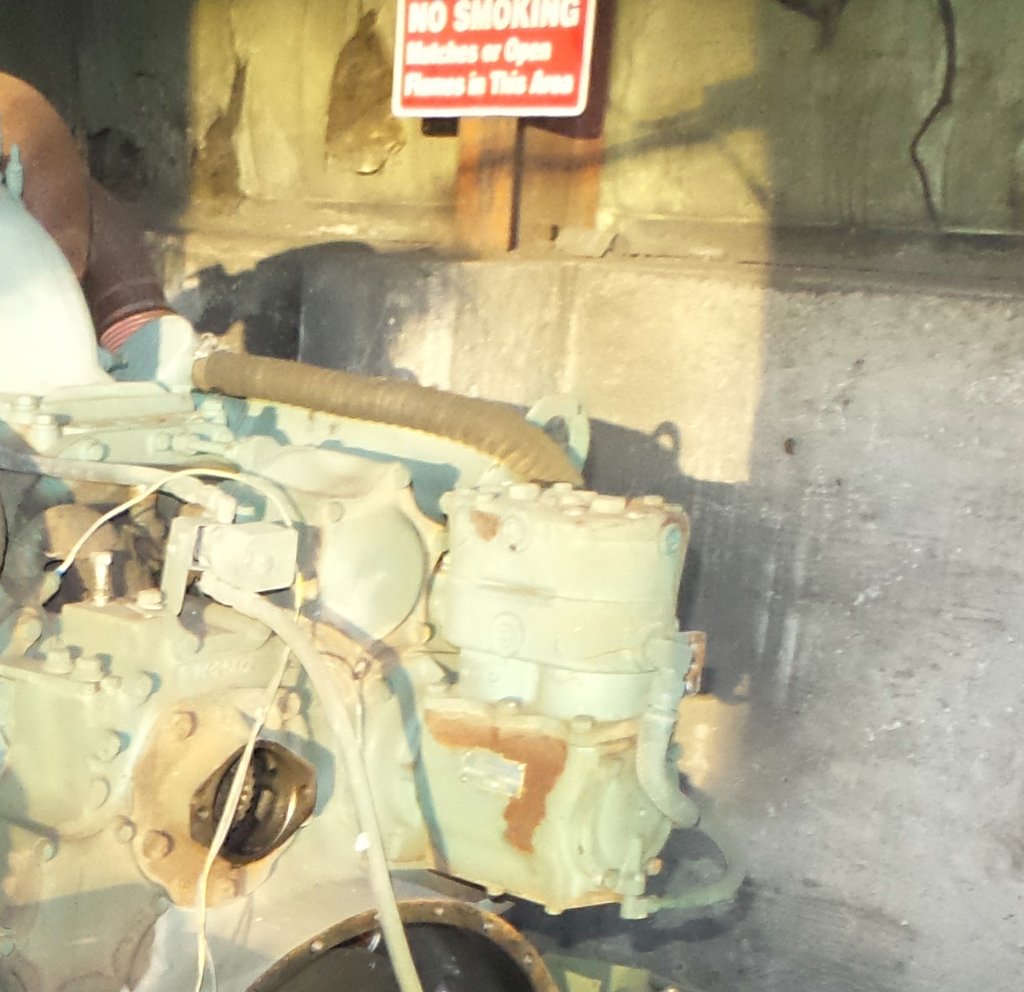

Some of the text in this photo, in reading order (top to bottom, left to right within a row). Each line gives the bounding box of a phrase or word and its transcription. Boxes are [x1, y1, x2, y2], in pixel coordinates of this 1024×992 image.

[407, 0, 582, 34] NO SMOKING
[405, 36, 552, 67] Matches or Open
[467, 70, 487, 95] in
[489, 70, 527, 95] This
[528, 69, 575, 95] Area
